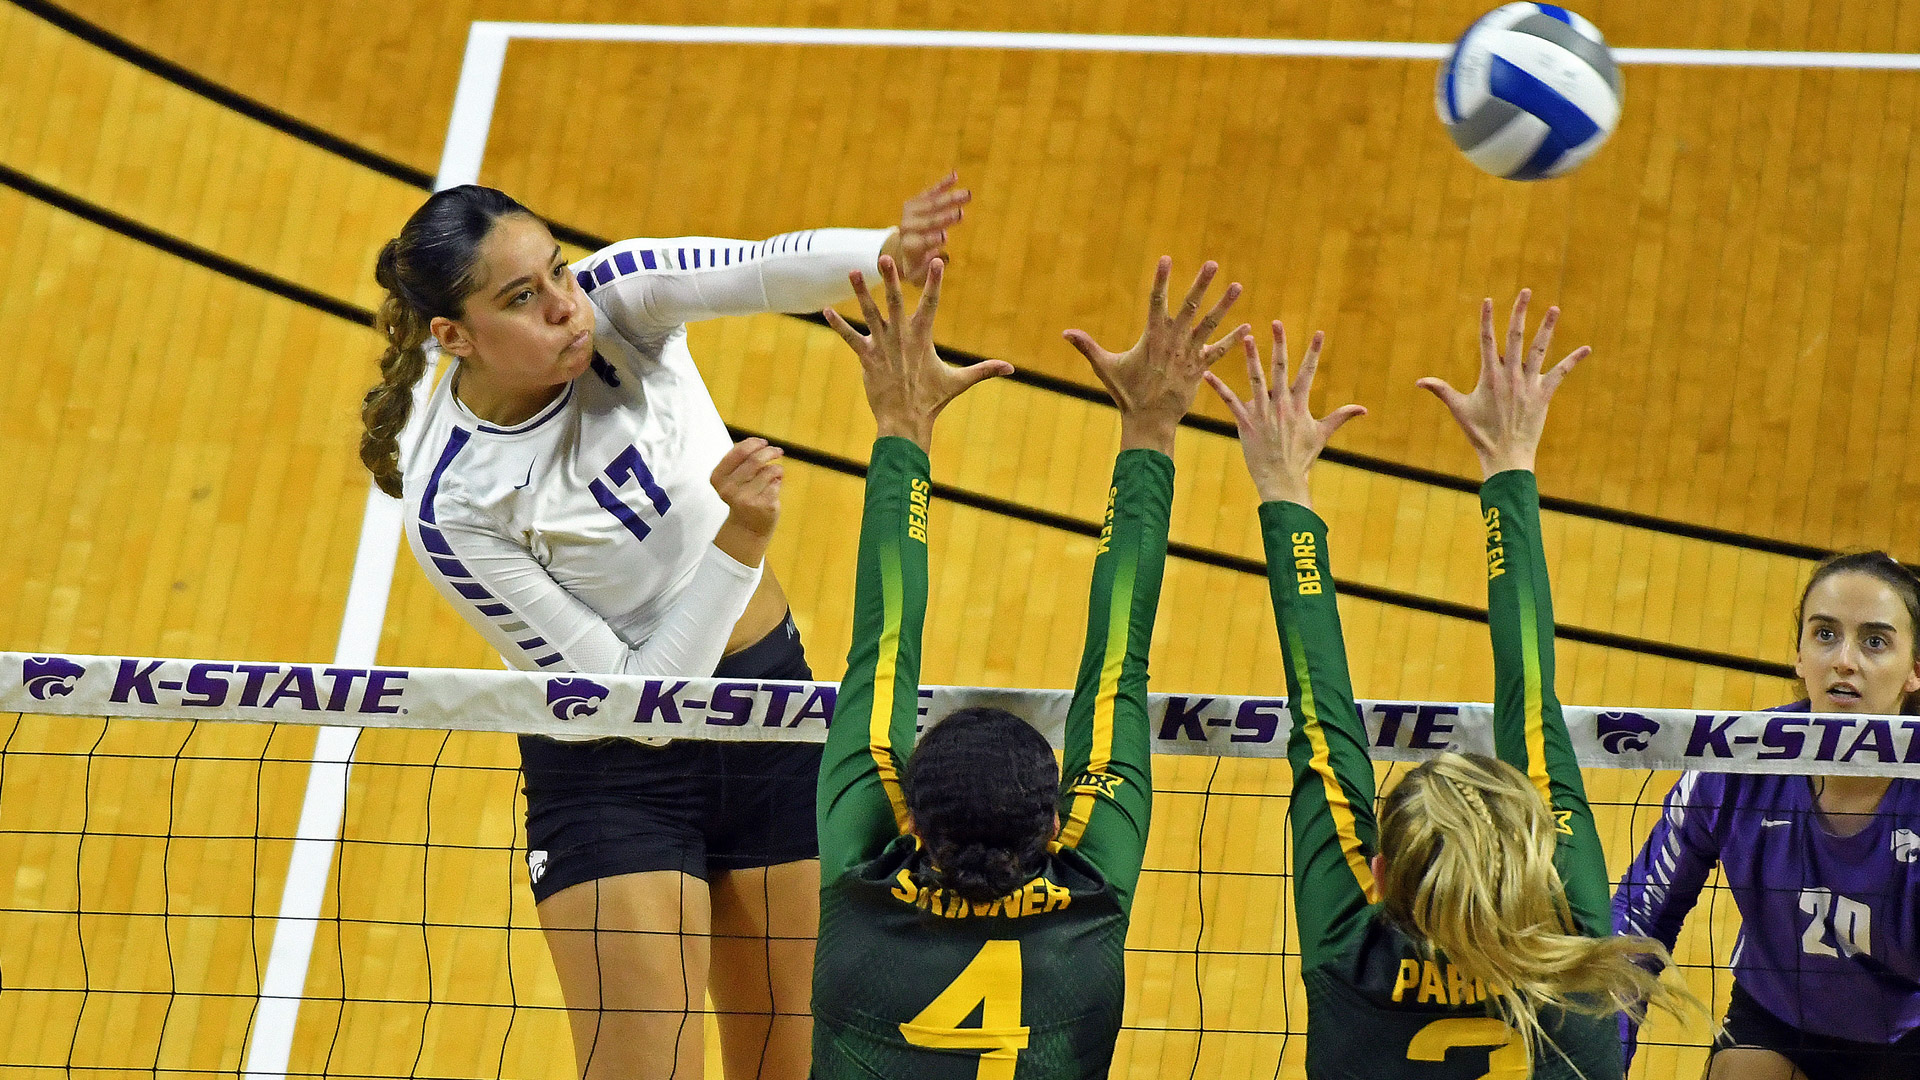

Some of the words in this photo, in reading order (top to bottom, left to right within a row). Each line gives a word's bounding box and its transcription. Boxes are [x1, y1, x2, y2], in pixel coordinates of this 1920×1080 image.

[588, 443, 672, 542] 17
[909, 478, 931, 544] BEARS
[1291, 531, 1323, 595] BEARS
[109, 659, 409, 714] K-STATE
[634, 680, 934, 732] K-STA
[1158, 696, 1459, 750] K-STE
[1799, 886, 1872, 958] 20
[899, 939, 1031, 1080] 4
